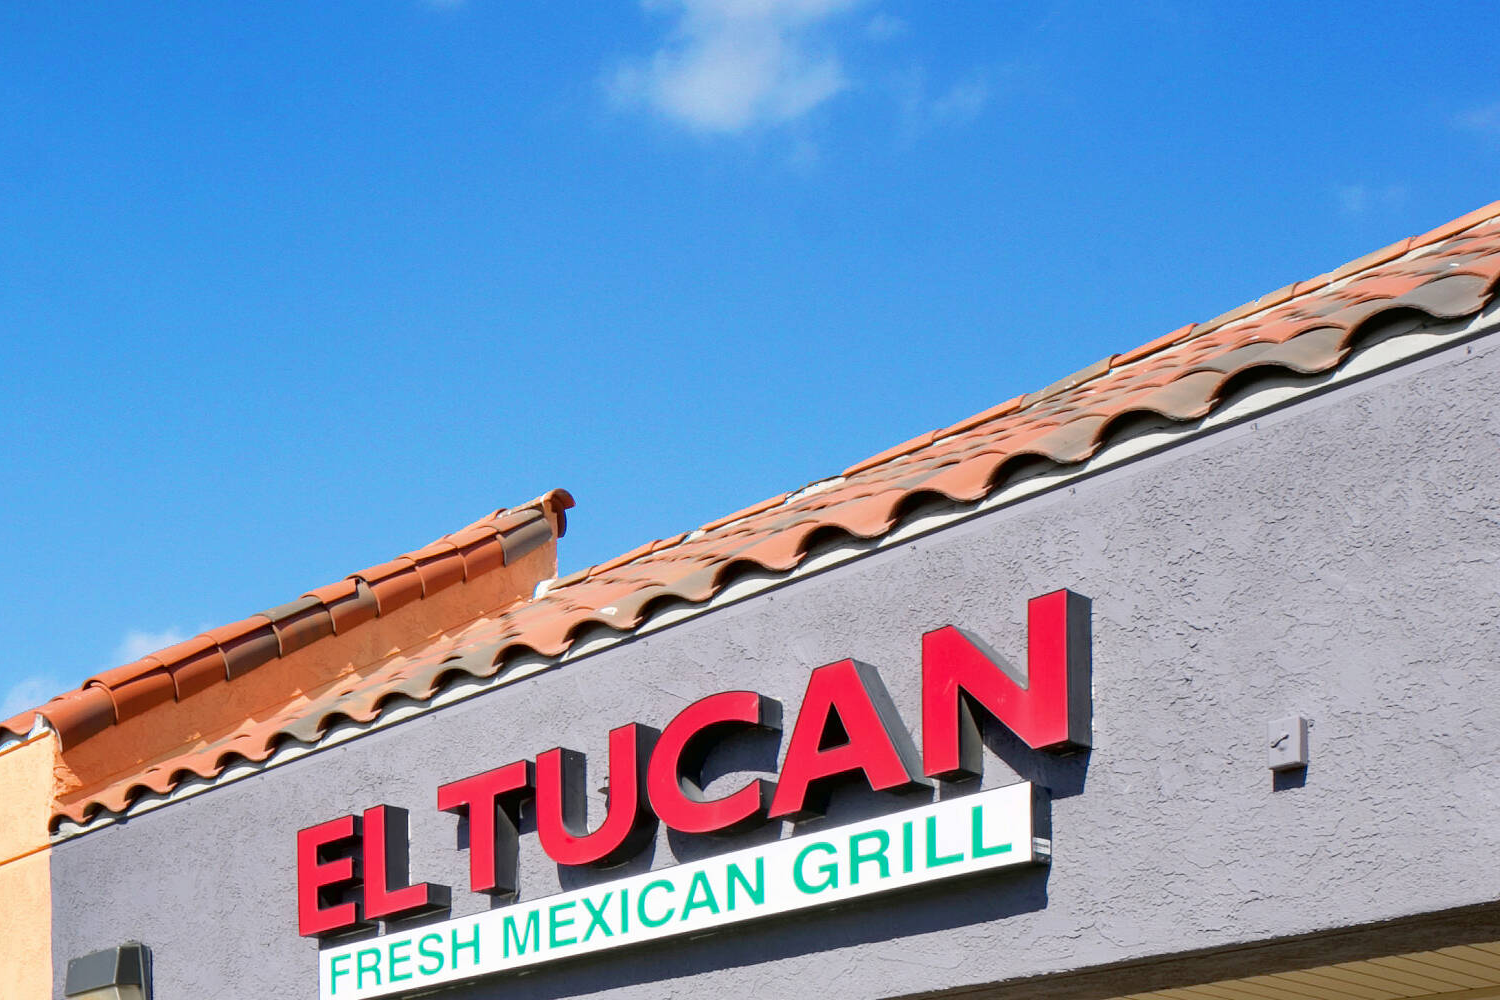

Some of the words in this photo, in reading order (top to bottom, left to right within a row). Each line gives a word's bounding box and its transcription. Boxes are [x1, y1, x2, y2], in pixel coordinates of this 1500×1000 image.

[297, 804, 436, 937] EL
[437, 587, 1072, 893] TUCAN
[329, 923, 482, 997] FRESH
[502, 856, 765, 959] MEXICAN
[792, 804, 1014, 896] GRILL
